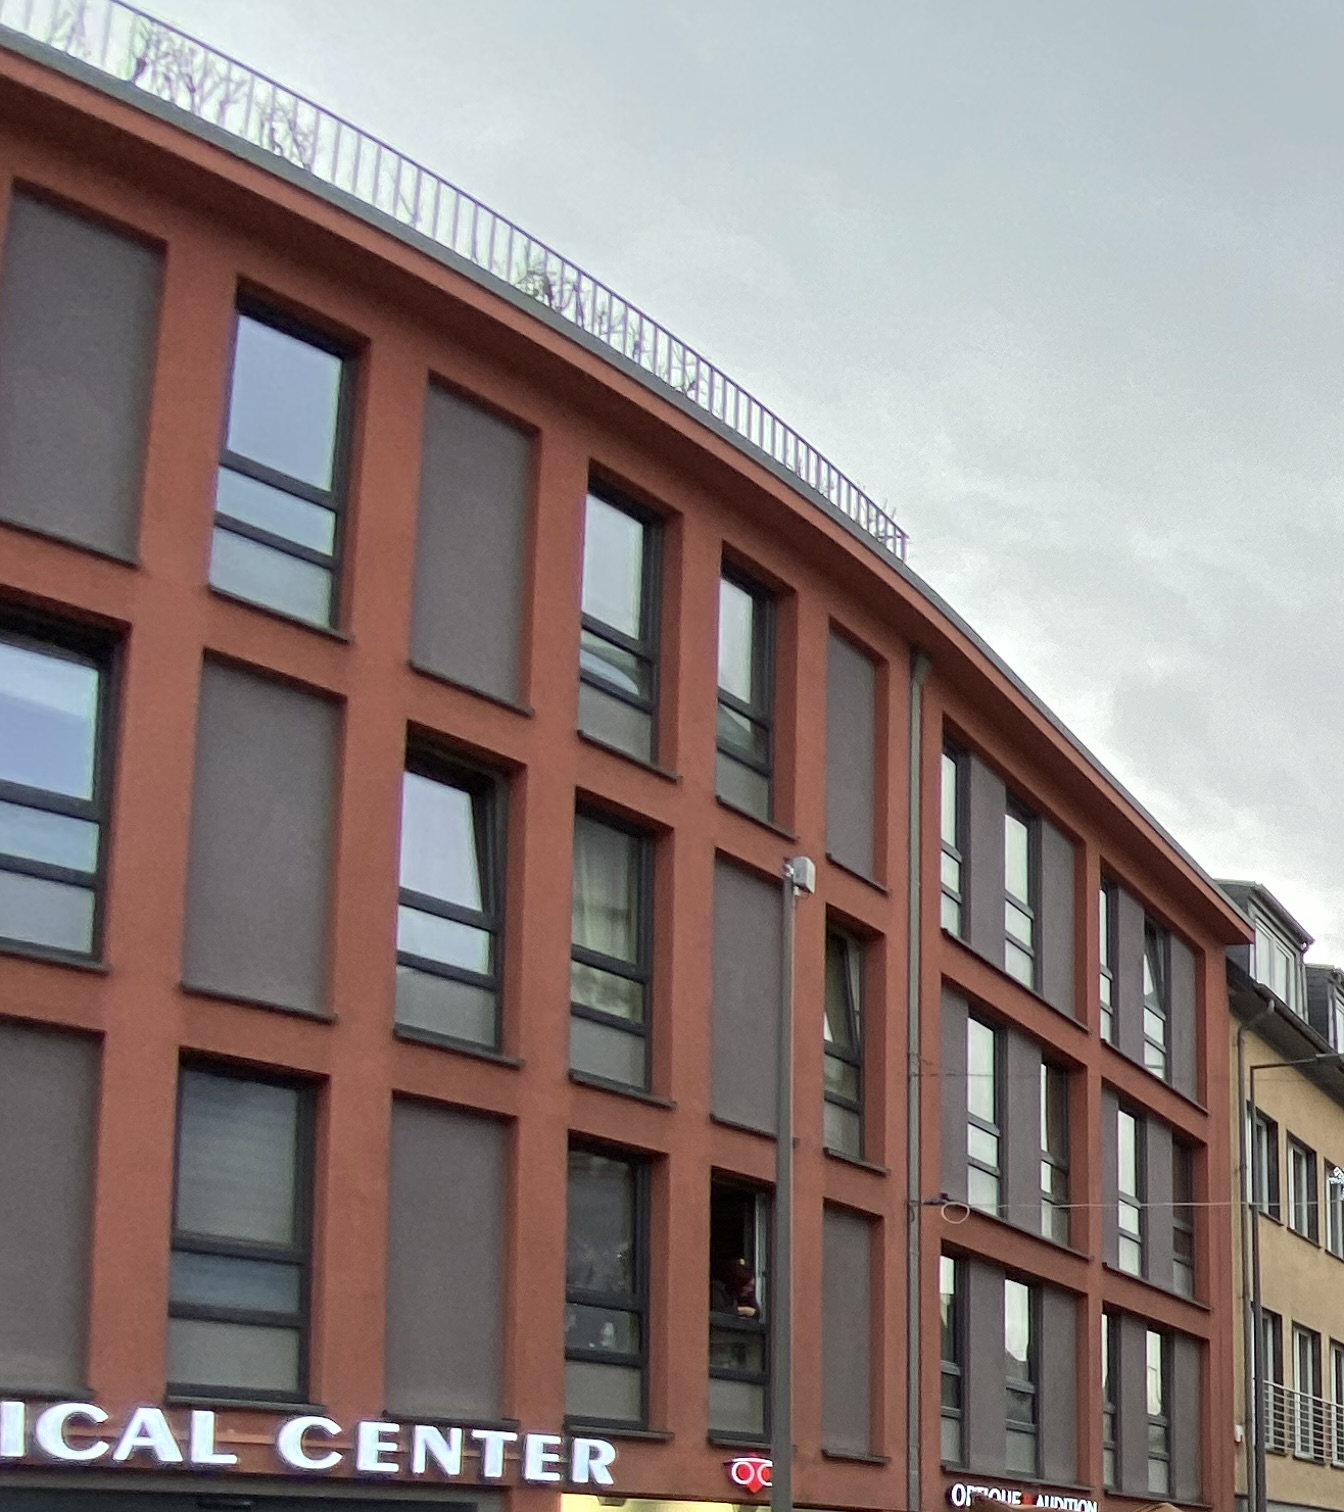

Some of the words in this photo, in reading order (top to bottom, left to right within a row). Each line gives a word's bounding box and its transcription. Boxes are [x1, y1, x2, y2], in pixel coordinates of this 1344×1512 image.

[0, 1401, 238, 1464] ICAL
[277, 1415, 617, 1486] CENTER
[951, 1483, 1022, 1506] OPQUE
